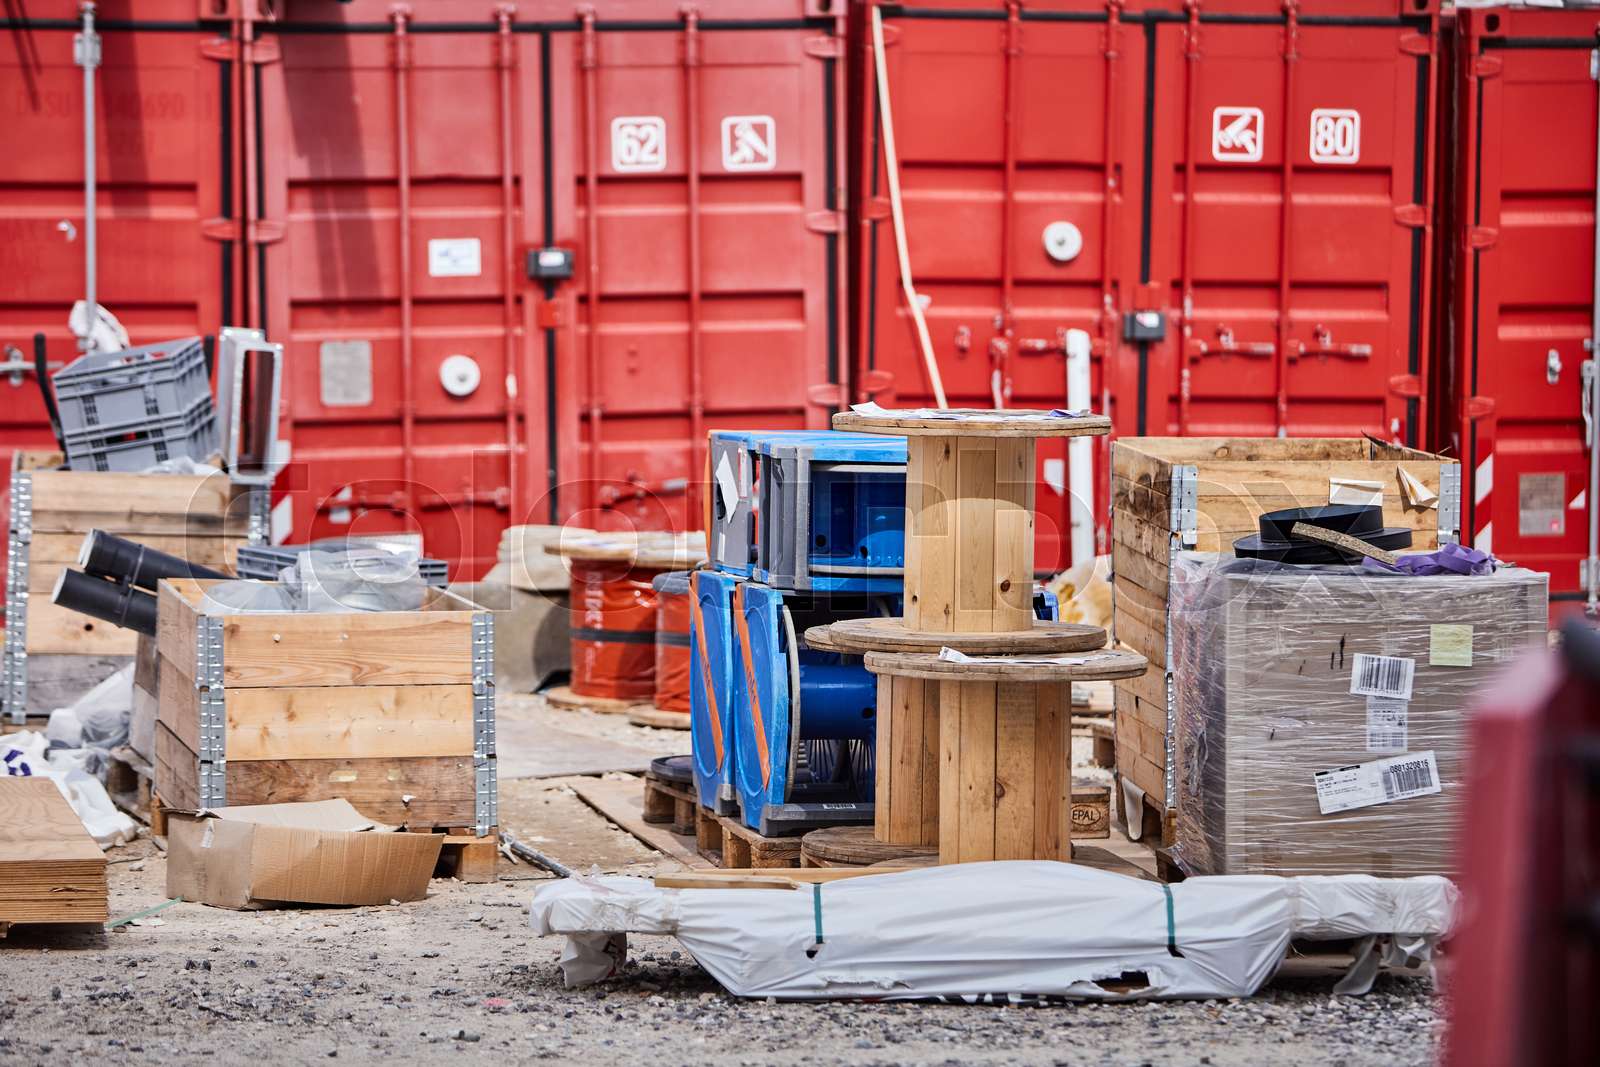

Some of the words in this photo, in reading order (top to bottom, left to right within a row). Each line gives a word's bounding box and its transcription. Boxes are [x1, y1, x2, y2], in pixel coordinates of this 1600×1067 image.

[620, 124, 660, 164] 62
[1315, 117, 1354, 156] 80
[1072, 809, 1096, 821] EPAL
